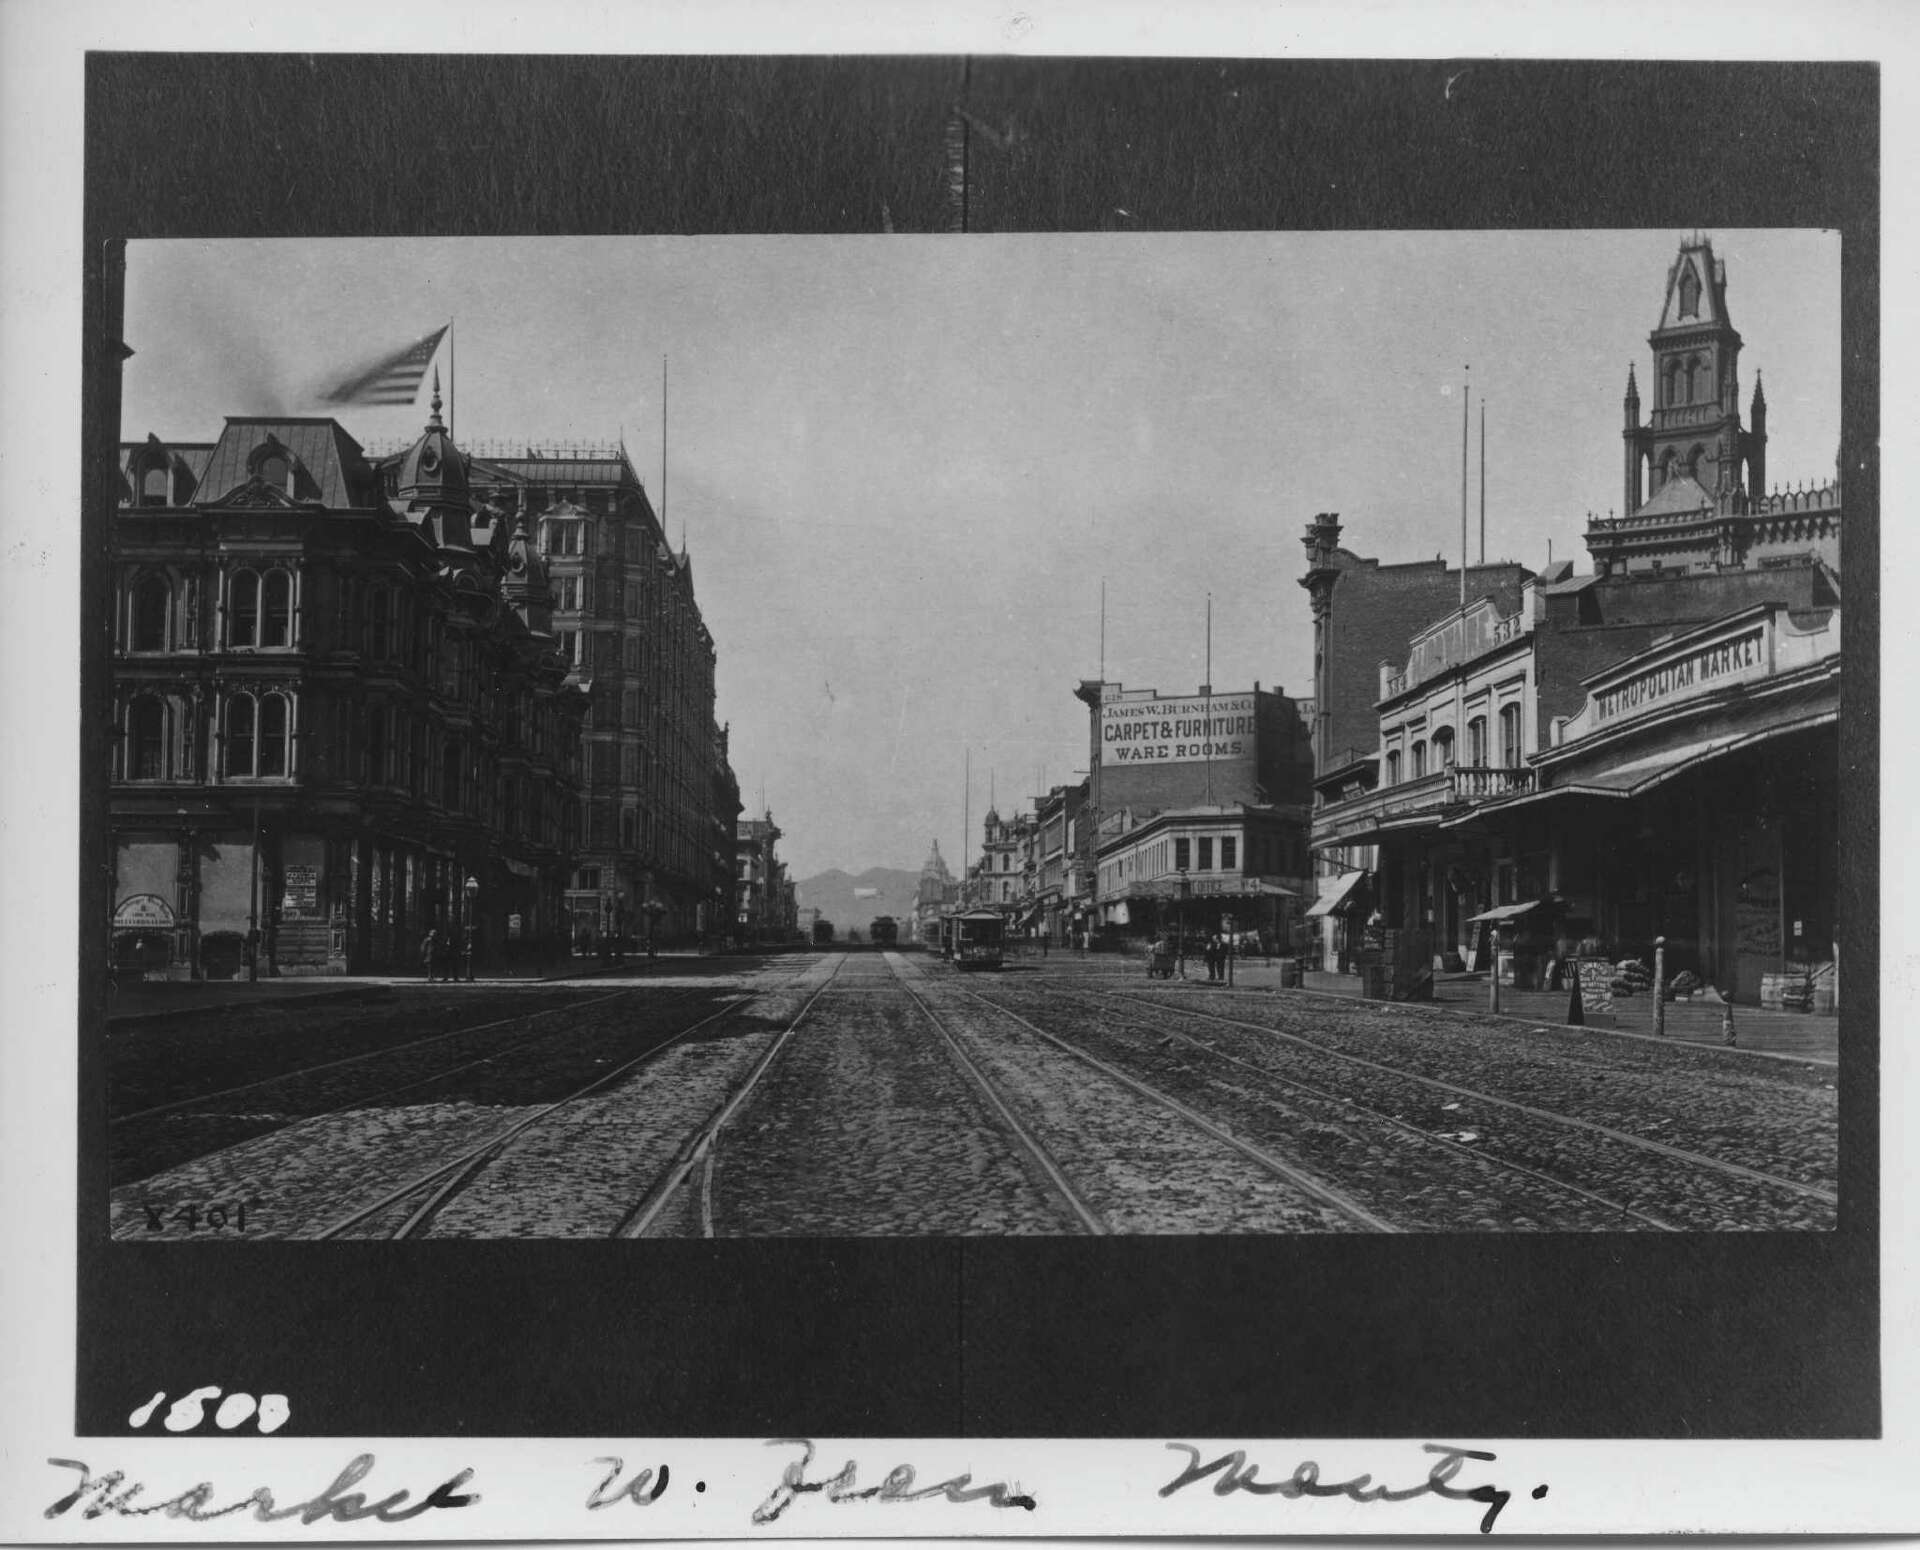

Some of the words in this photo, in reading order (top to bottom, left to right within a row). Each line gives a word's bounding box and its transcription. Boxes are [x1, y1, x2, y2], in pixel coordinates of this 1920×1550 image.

[1599, 658, 1695, 721] METROPOLITAN
[1700, 637, 1763, 682] MARKET
[1104, 721, 1160, 742] CARPET
[1160, 720, 1173, 739] &
[1175, 716, 1256, 738] FURNITURE
[1115, 745, 1169, 760] WARE
